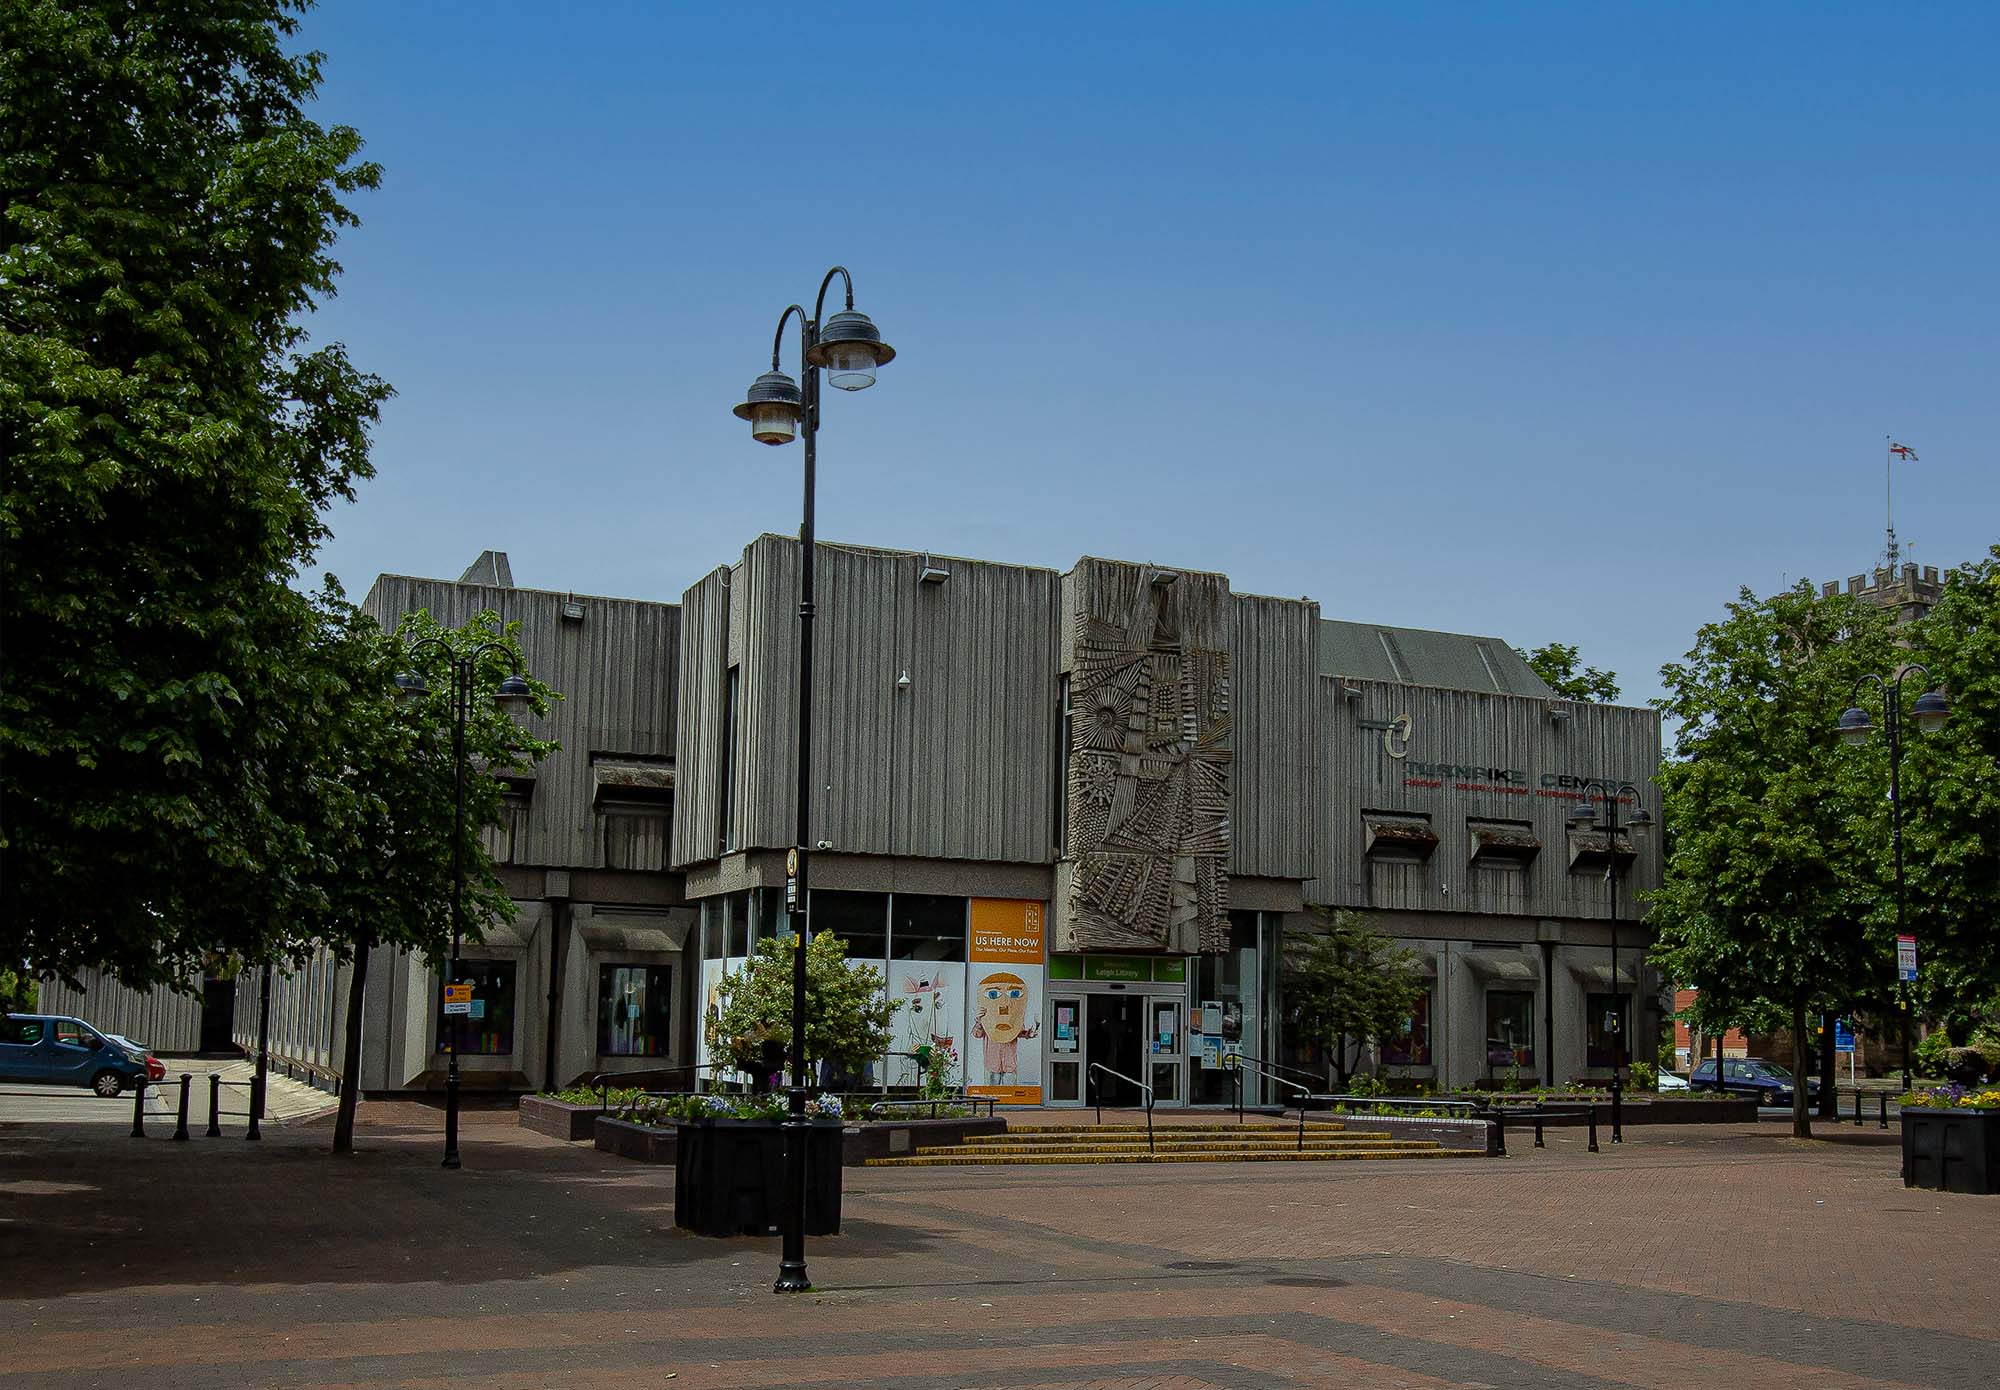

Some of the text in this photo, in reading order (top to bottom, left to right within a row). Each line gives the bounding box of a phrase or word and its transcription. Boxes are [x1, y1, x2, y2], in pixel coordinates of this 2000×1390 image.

[1405, 761, 1526, 784] TURNPIKE
[975, 936, 1039, 947] US HERE NOW
[1096, 968, 1138, 977] Leigh Library
